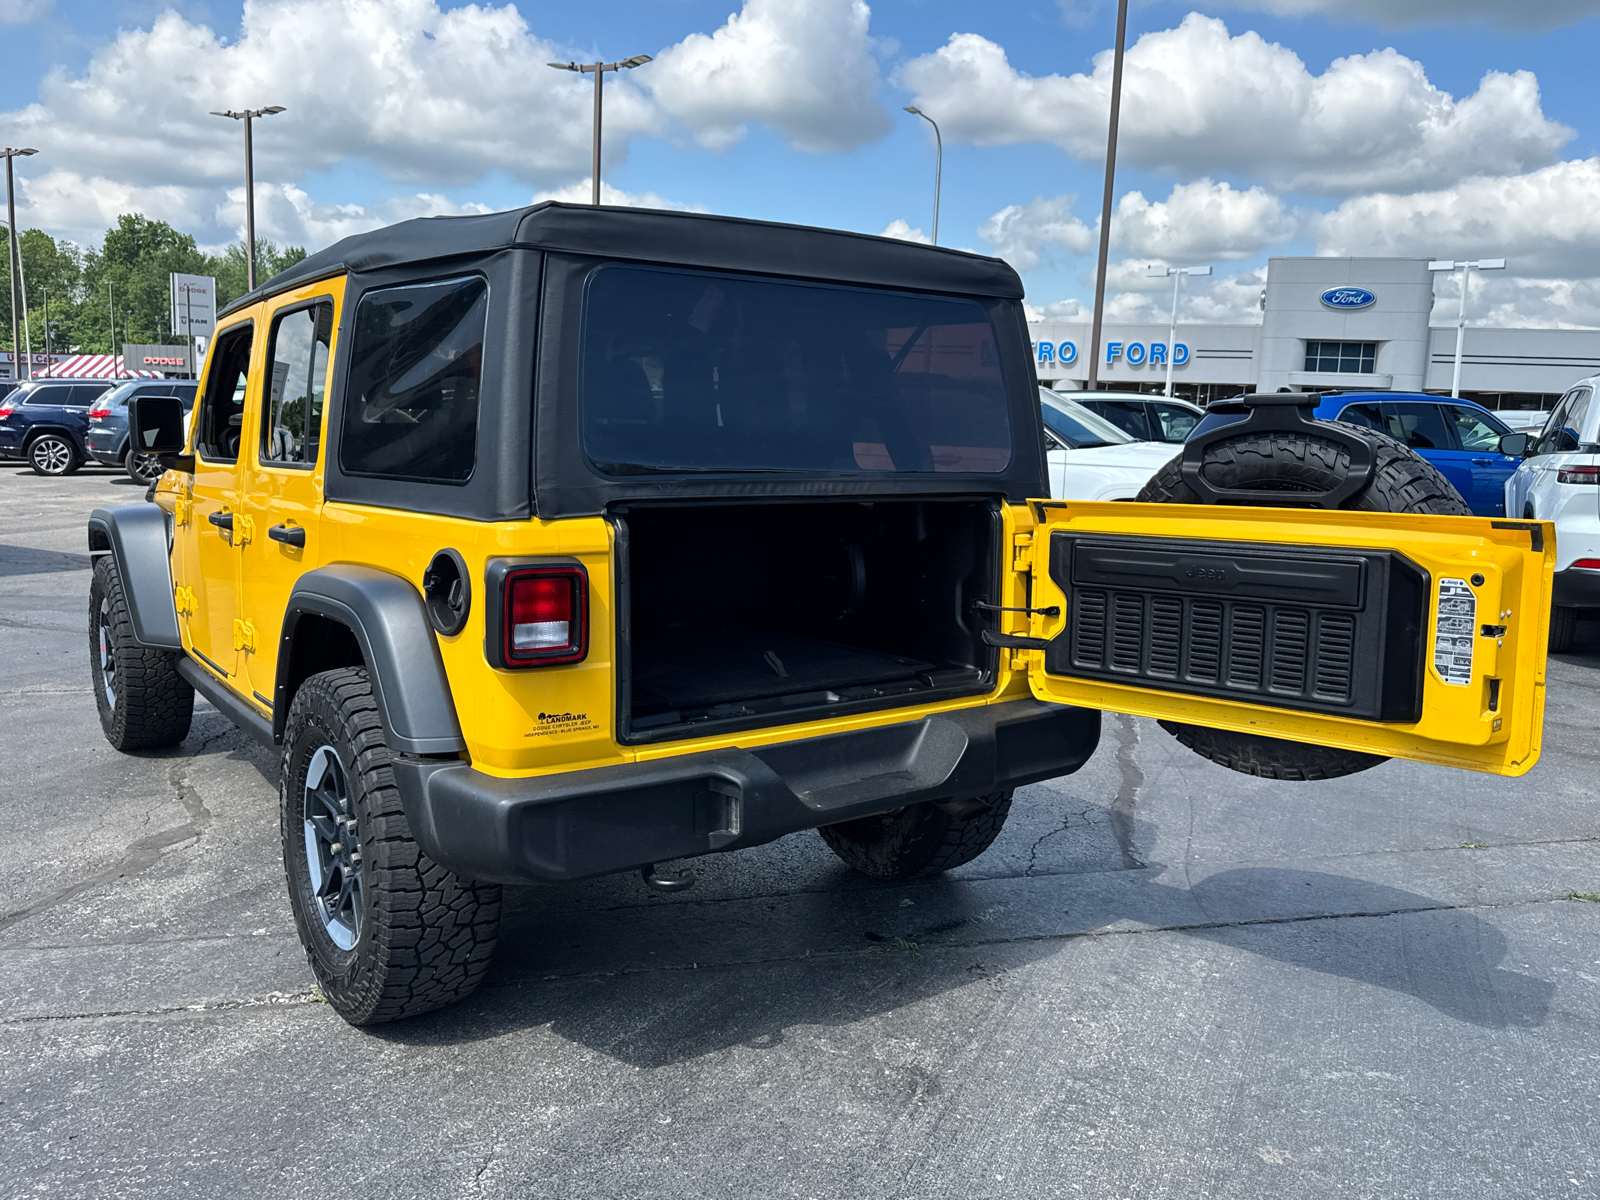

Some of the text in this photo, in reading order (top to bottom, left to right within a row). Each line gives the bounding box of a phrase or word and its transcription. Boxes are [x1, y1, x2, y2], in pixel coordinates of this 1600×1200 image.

[1332, 290, 1364, 303] Ford
[1106, 342, 1190, 365] FORD
[143, 357, 184, 365] DODGE
[1185, 564, 1226, 581] Jeep
[546, 713, 587, 724] LANDMARK
[552, 721, 578, 729] CHRYSLER
[523, 729, 558, 738] INDEPENDENCE
